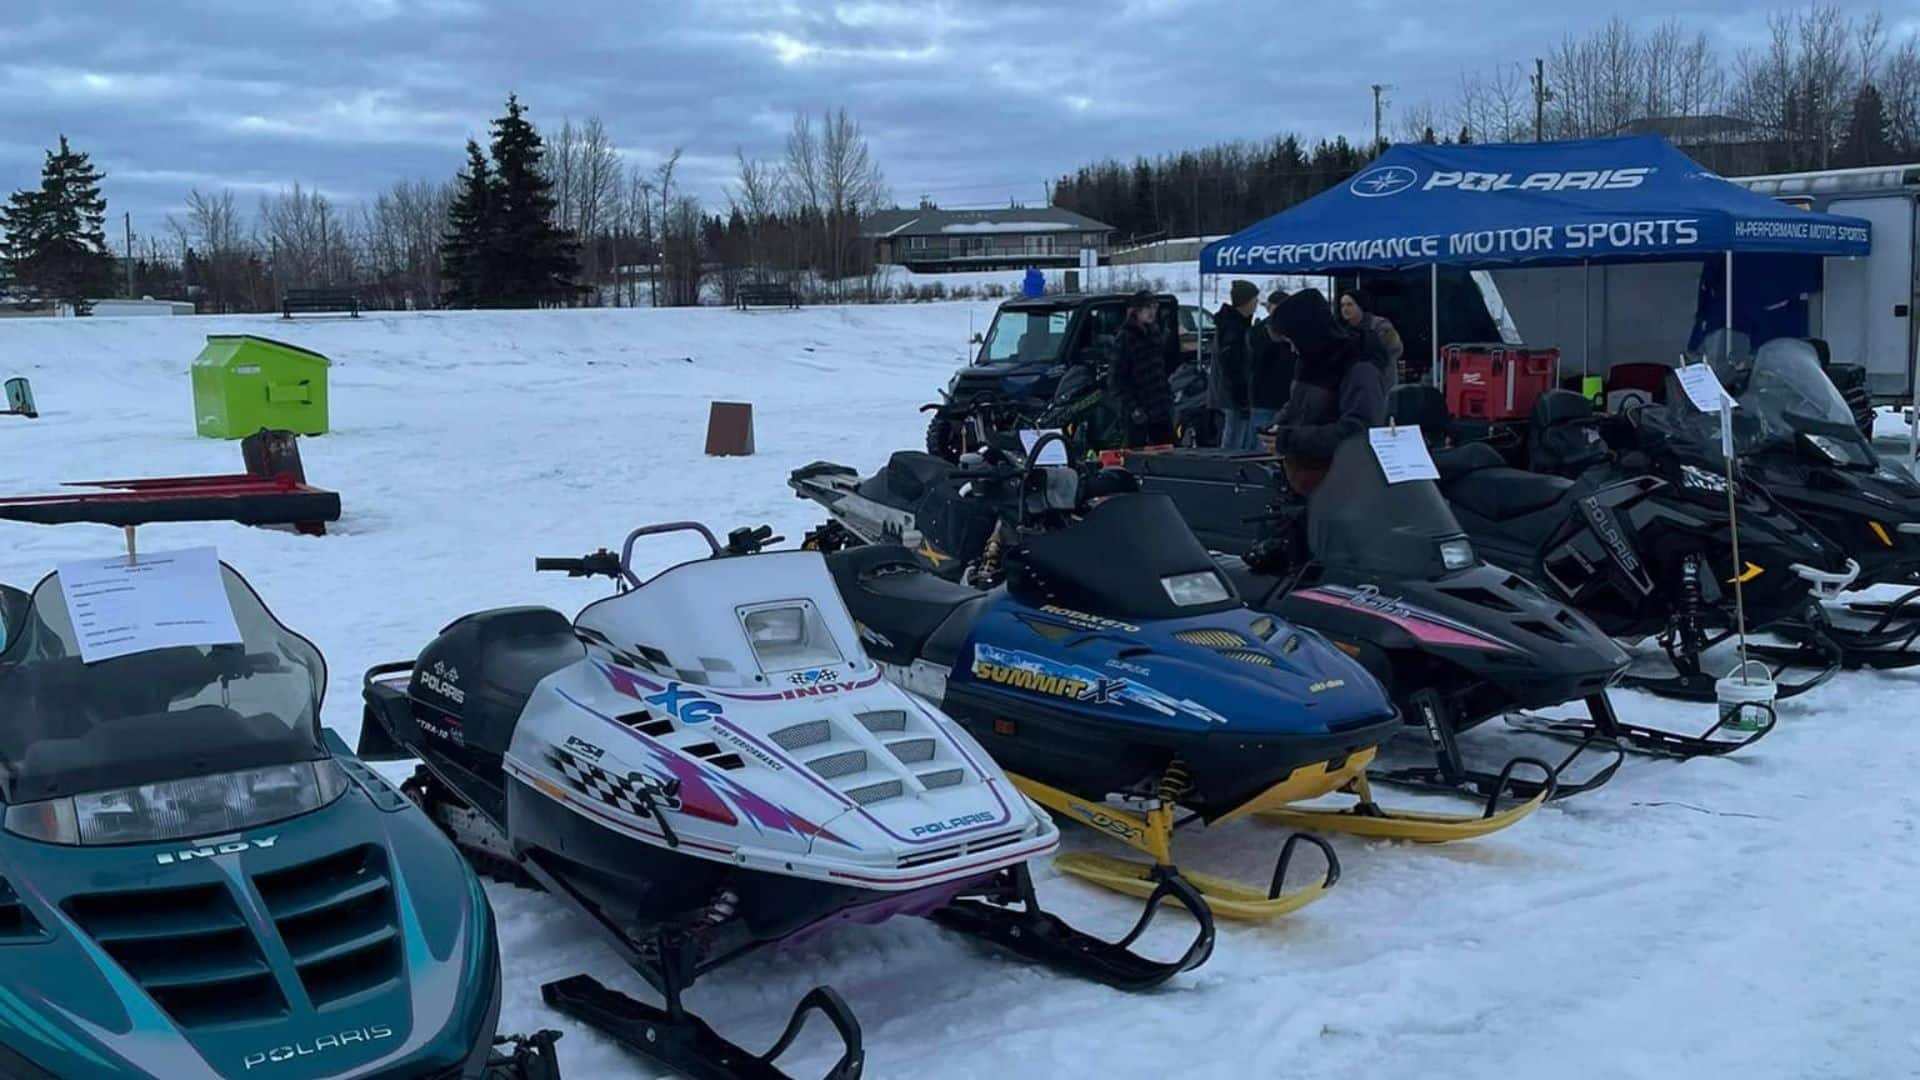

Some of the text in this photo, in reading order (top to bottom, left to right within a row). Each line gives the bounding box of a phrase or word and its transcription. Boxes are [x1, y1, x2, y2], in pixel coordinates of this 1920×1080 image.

[1422, 168, 1649, 192] POLARIS
[1216, 219, 1699, 267] HI-PERFORMANCE MOTOR SPORTS
[1735, 220, 1868, 242] HI-PERFORMANCE MOTOR SPORTS
[1585, 496, 1640, 571] POLARIS
[420, 670, 465, 704] POLARIS
[783, 681, 855, 700] INDY
[976, 661, 1089, 699] SUMMIT
[643, 682, 724, 724] XC
[911, 810, 995, 837] POLARIS
[156, 835, 279, 865] INDY
[244, 1024, 393, 1070] POLARIS
